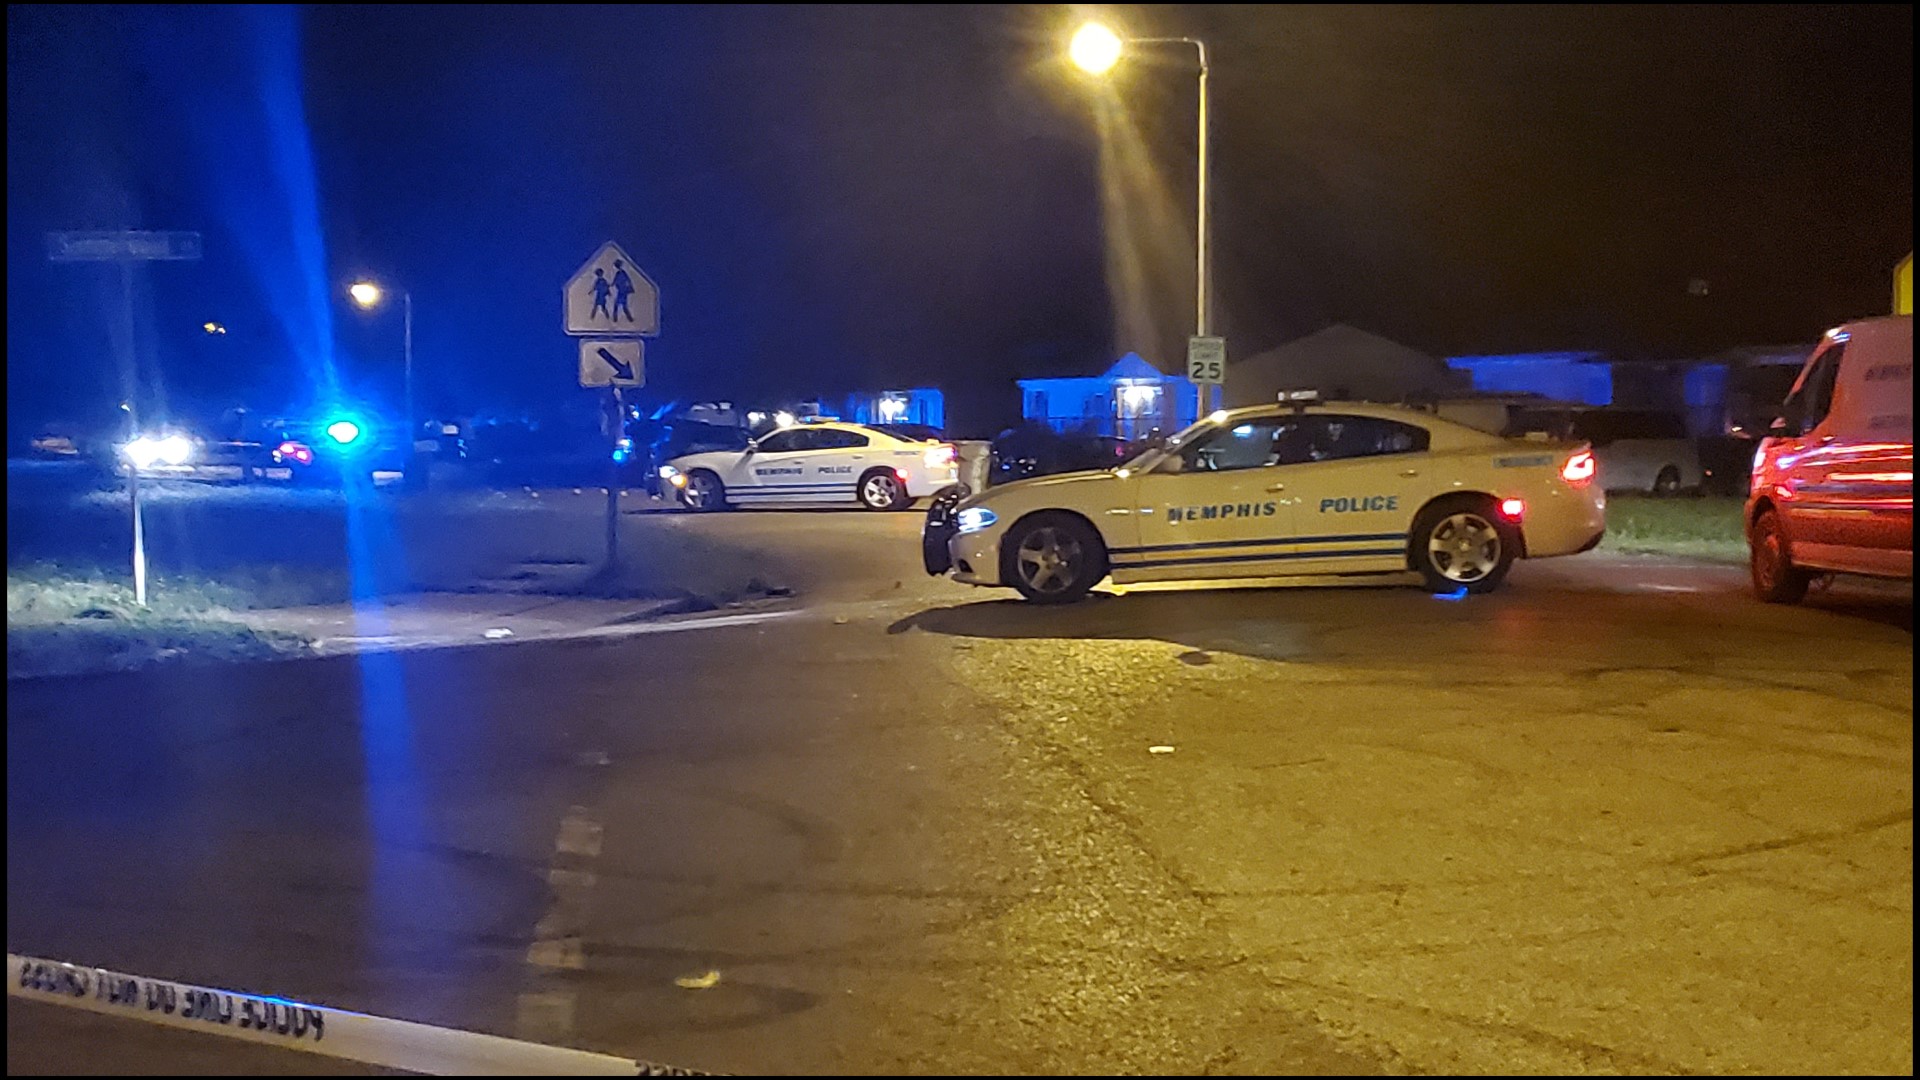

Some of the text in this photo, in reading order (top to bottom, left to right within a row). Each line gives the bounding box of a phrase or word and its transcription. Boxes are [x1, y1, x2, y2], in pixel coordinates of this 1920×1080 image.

[1192, 361, 1221, 379] 25
[818, 466, 852, 474] POLICE
[1167, 495, 1398, 522] MEMPHIS POLICE
